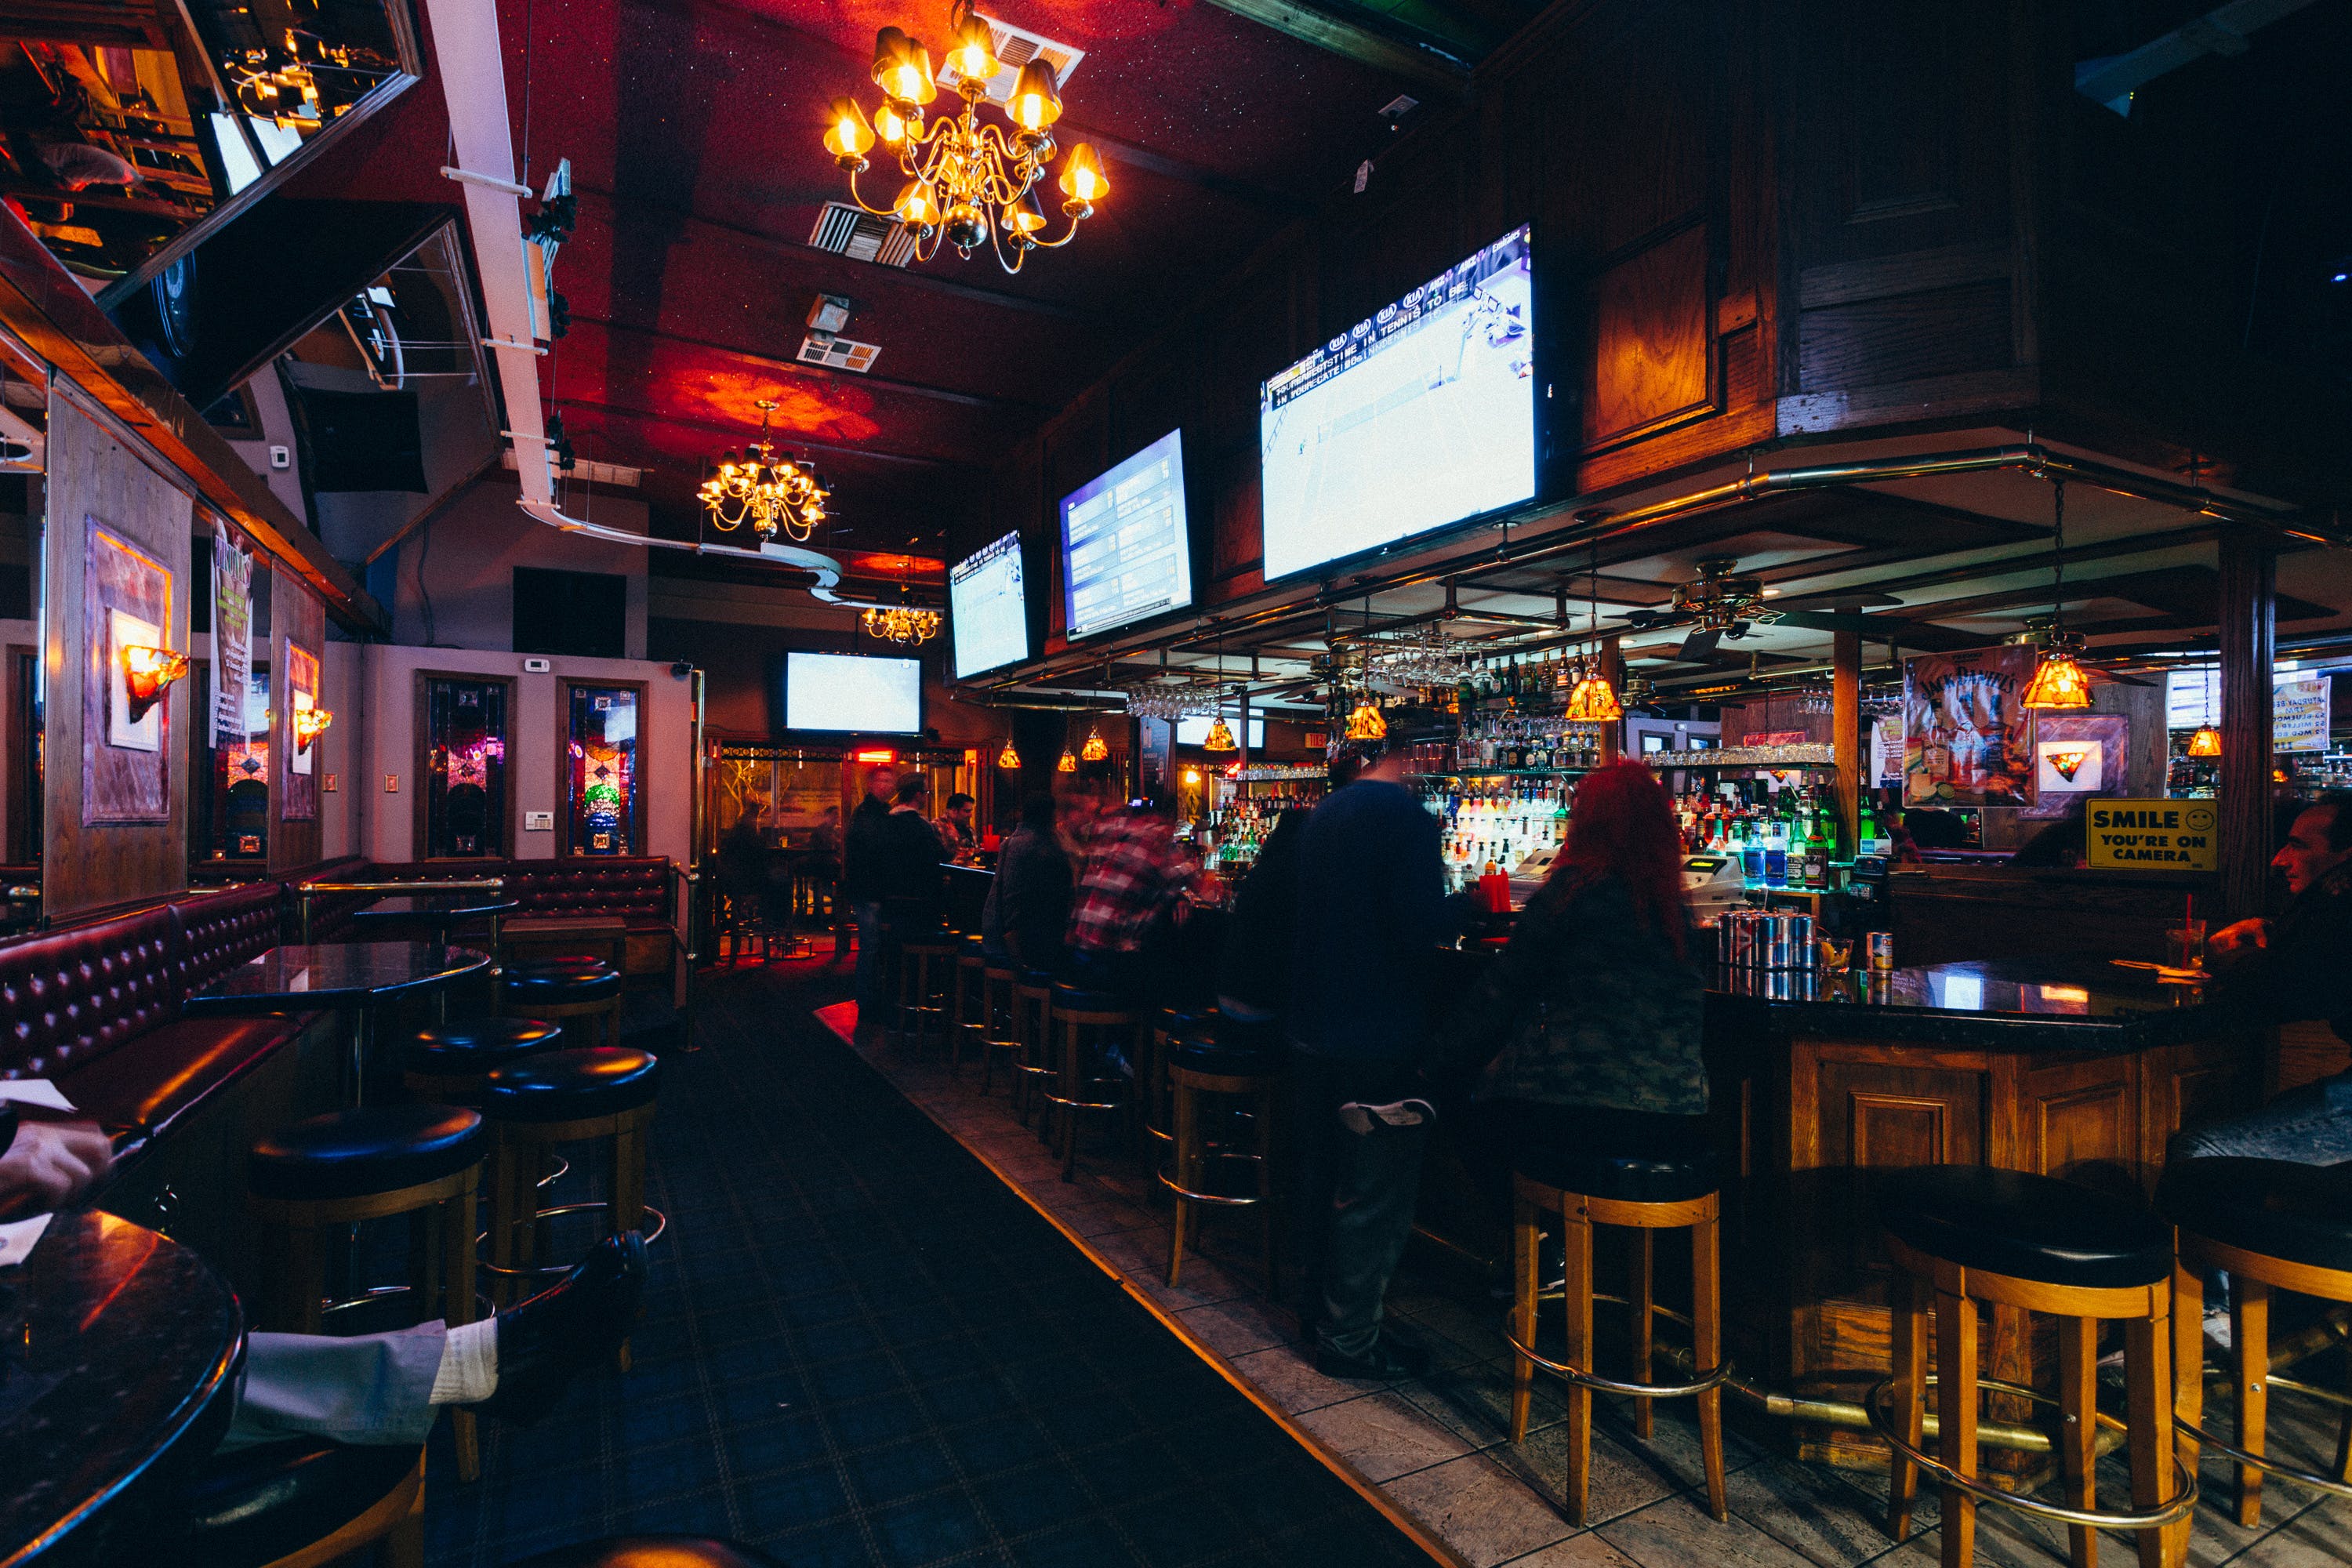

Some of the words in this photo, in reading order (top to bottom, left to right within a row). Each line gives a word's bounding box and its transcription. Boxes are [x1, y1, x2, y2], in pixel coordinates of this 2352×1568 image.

[1330, 334, 1347, 350] KIA
[1355, 321, 1370, 336] KIA
[1379, 305, 1396, 322] KIA
[1405, 289, 1422, 306] KIA
[1381, 307, 1421, 336] TENNIS
[1427, 296, 1442, 310] TO
[1921, 673, 1955, 700] JACK
[1957, 666, 2018, 694] DANIEL'S
[2093, 810, 2180, 829] SMILE
[2101, 834, 2168, 847] YOU'RE
[2177, 836, 2206, 848] ON
[2113, 849, 2191, 862] CAMERA
